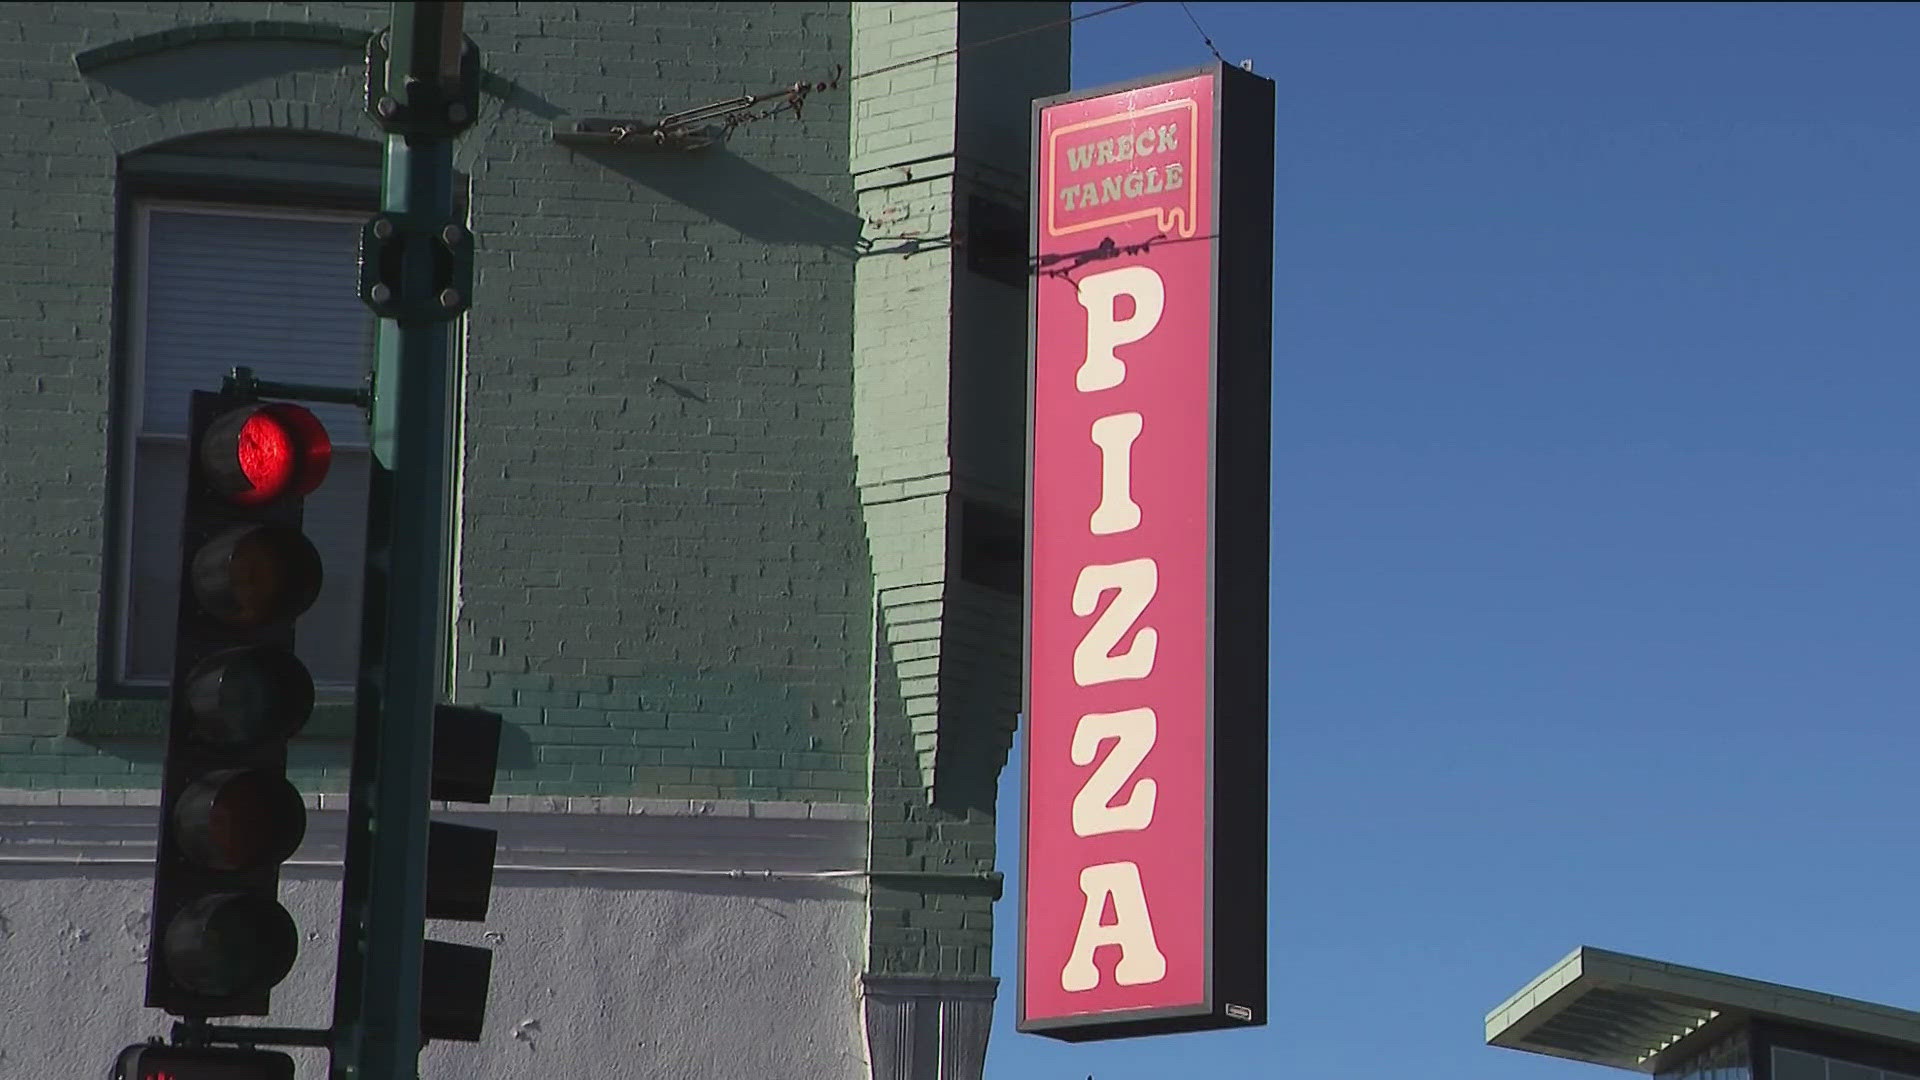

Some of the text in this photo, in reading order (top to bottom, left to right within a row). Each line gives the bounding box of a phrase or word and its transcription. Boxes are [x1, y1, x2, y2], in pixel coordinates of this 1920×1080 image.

[1066, 123, 1178, 172] WRECK
[1060, 163, 1184, 211] TANGLE
[1060, 265, 1167, 992] PIZZA
